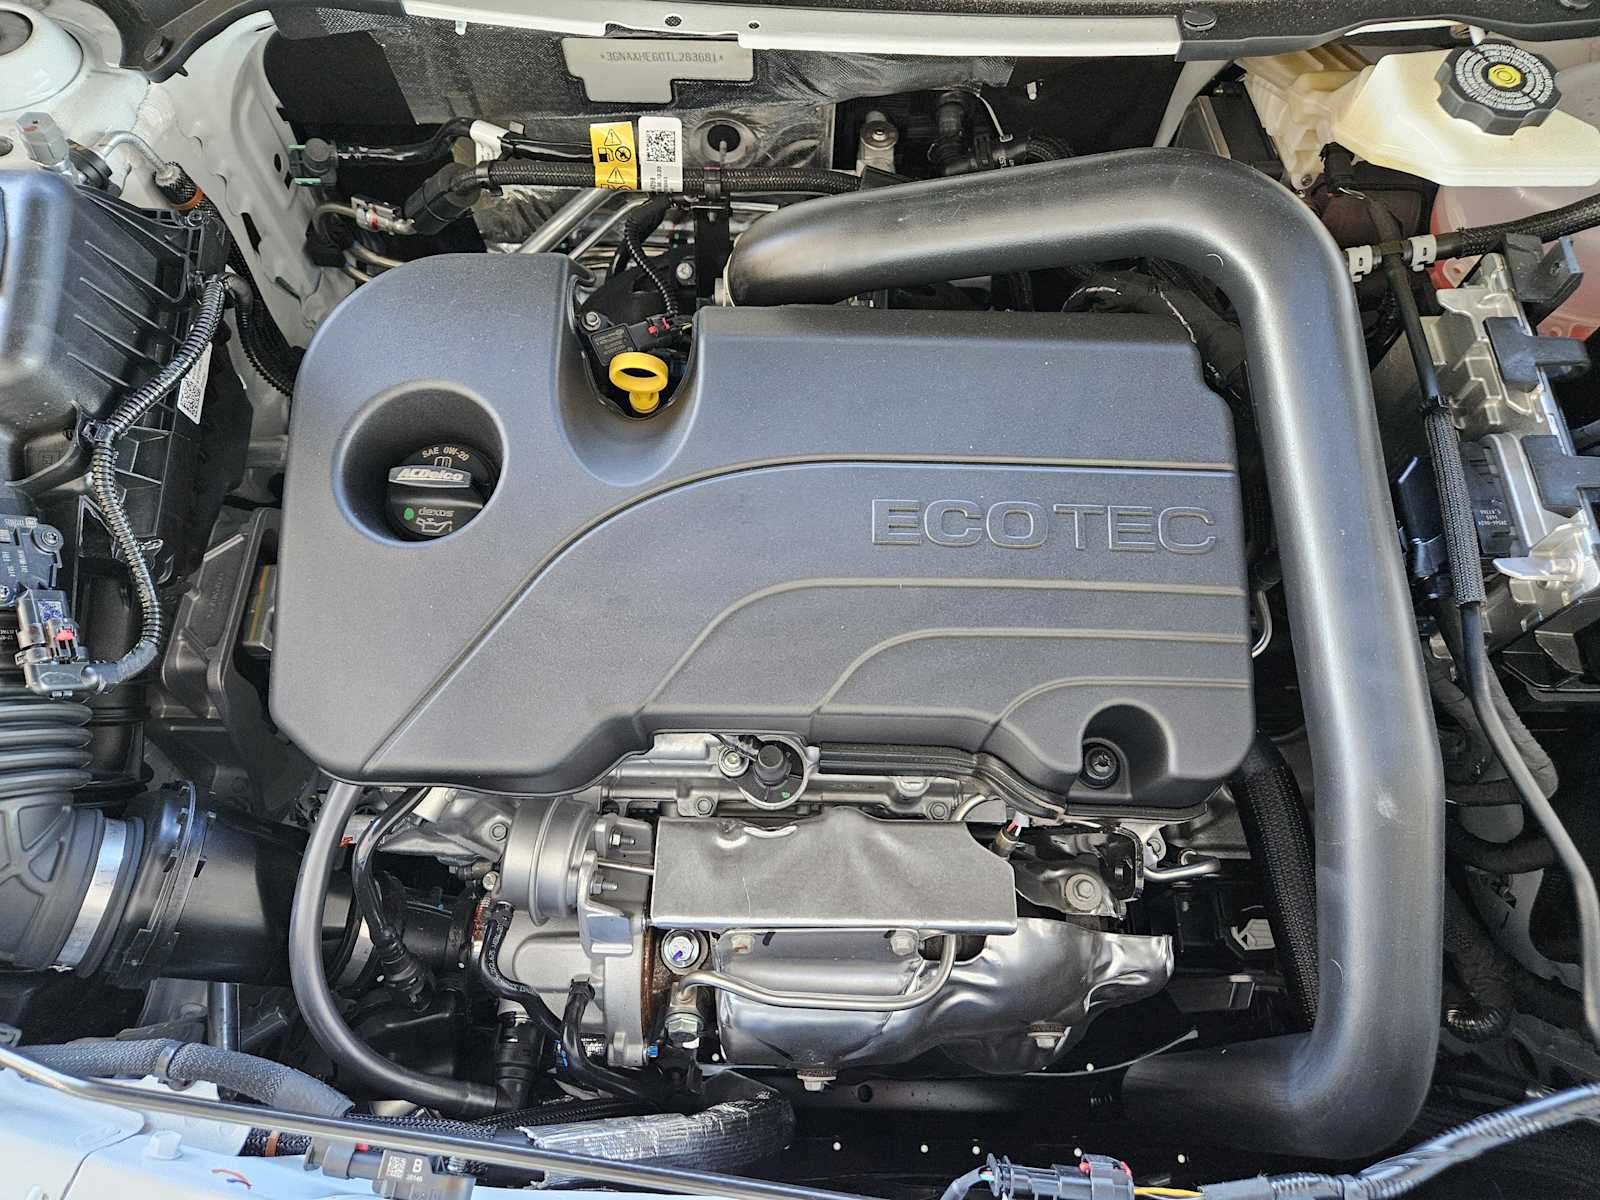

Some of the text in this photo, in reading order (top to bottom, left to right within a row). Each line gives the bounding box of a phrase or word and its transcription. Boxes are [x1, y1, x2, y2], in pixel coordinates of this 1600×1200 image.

[422, 447, 470, 462] SAE 0W-20
[397, 468, 464, 482] ACDelco
[418, 507, 455, 517] dexos
[872, 499, 1216, 554] ECOTEC
